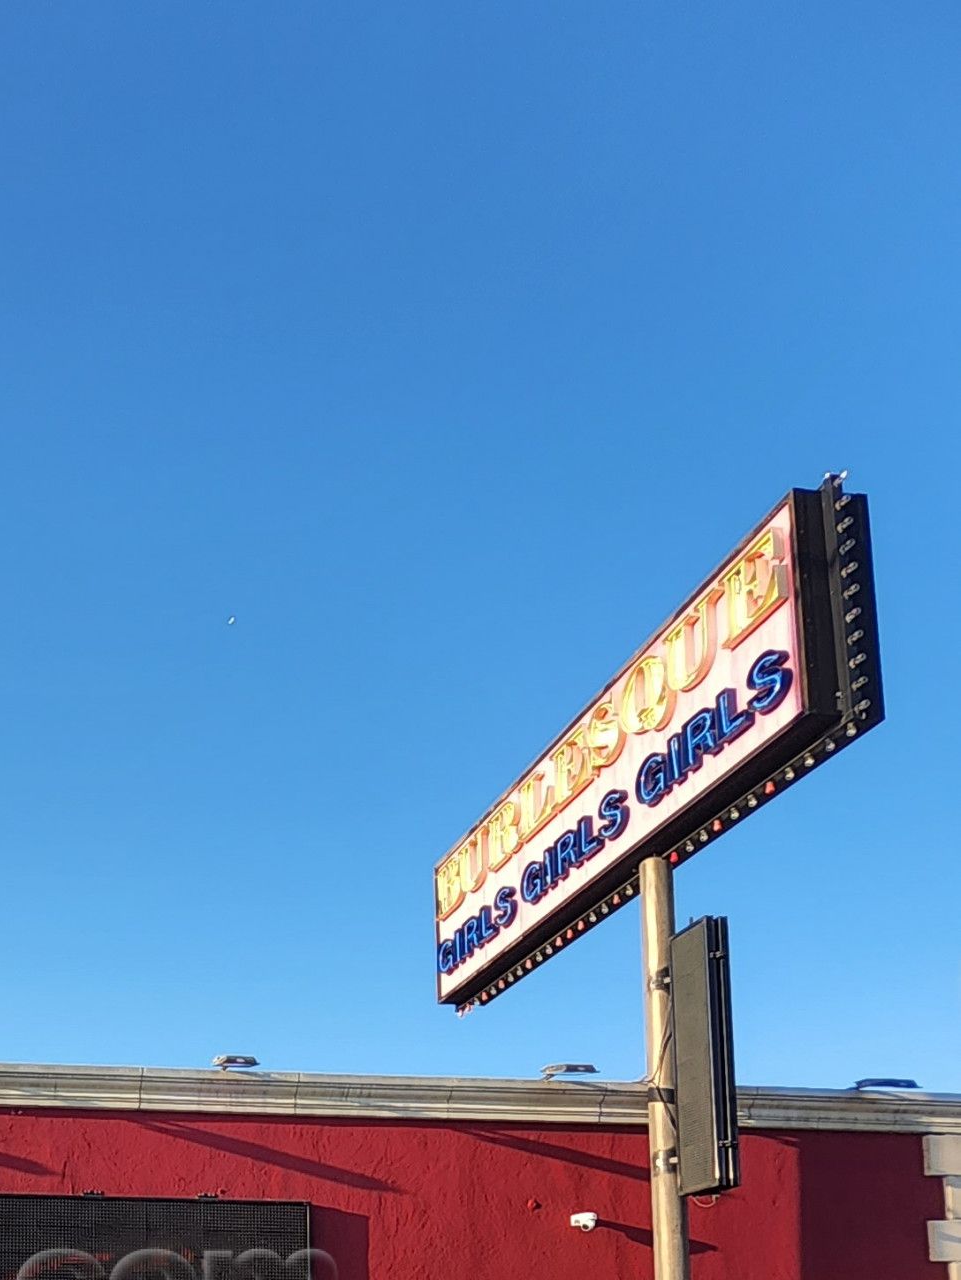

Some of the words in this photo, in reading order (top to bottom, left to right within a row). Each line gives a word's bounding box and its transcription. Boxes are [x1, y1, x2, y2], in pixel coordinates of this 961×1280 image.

[437, 527, 788, 920] BURLESQUE
[439, 886, 518, 975] GIRLS
[520, 789, 630, 905] GIRLS
[635, 649, 792, 806] GIRLS
